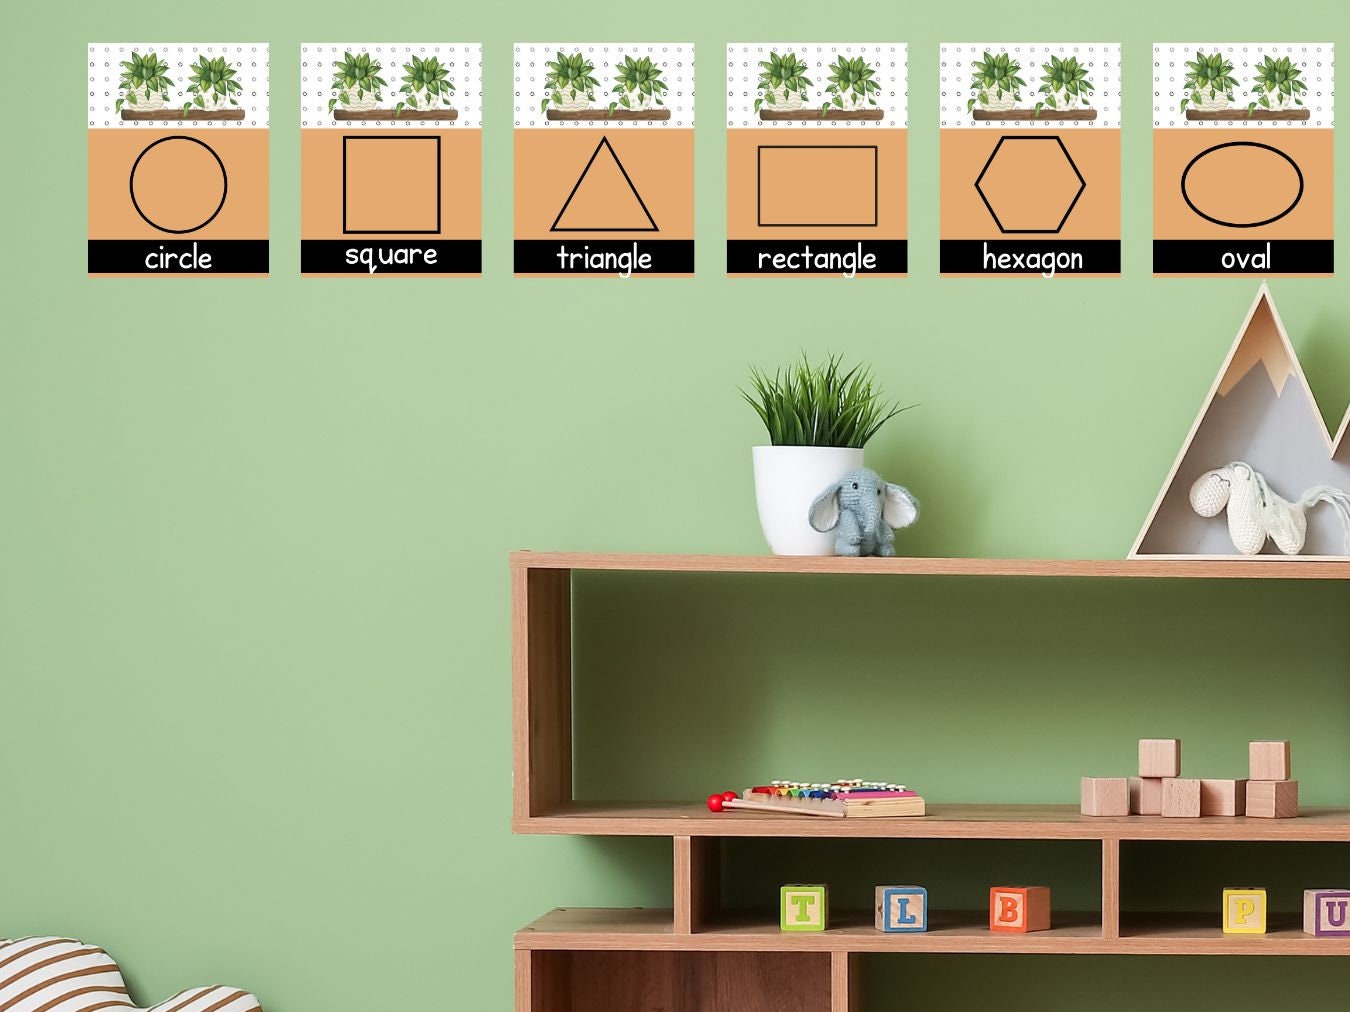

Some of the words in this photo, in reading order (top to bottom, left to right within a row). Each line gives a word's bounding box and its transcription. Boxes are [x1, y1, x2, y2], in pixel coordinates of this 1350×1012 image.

[144, 241, 213, 269] circle
[345, 247, 438, 275] square
[556, 241, 652, 278] triangle
[758, 241, 877, 278] rectangle
[983, 241, 1083, 278] hexagon
[1221, 241, 1271, 269] oval
[790, 895, 815, 922] T
[897, 897, 916, 924] L
[999, 896, 1018, 923] B
[1235, 899, 1256, 924] P
[1325, 901, 1348, 927] U
